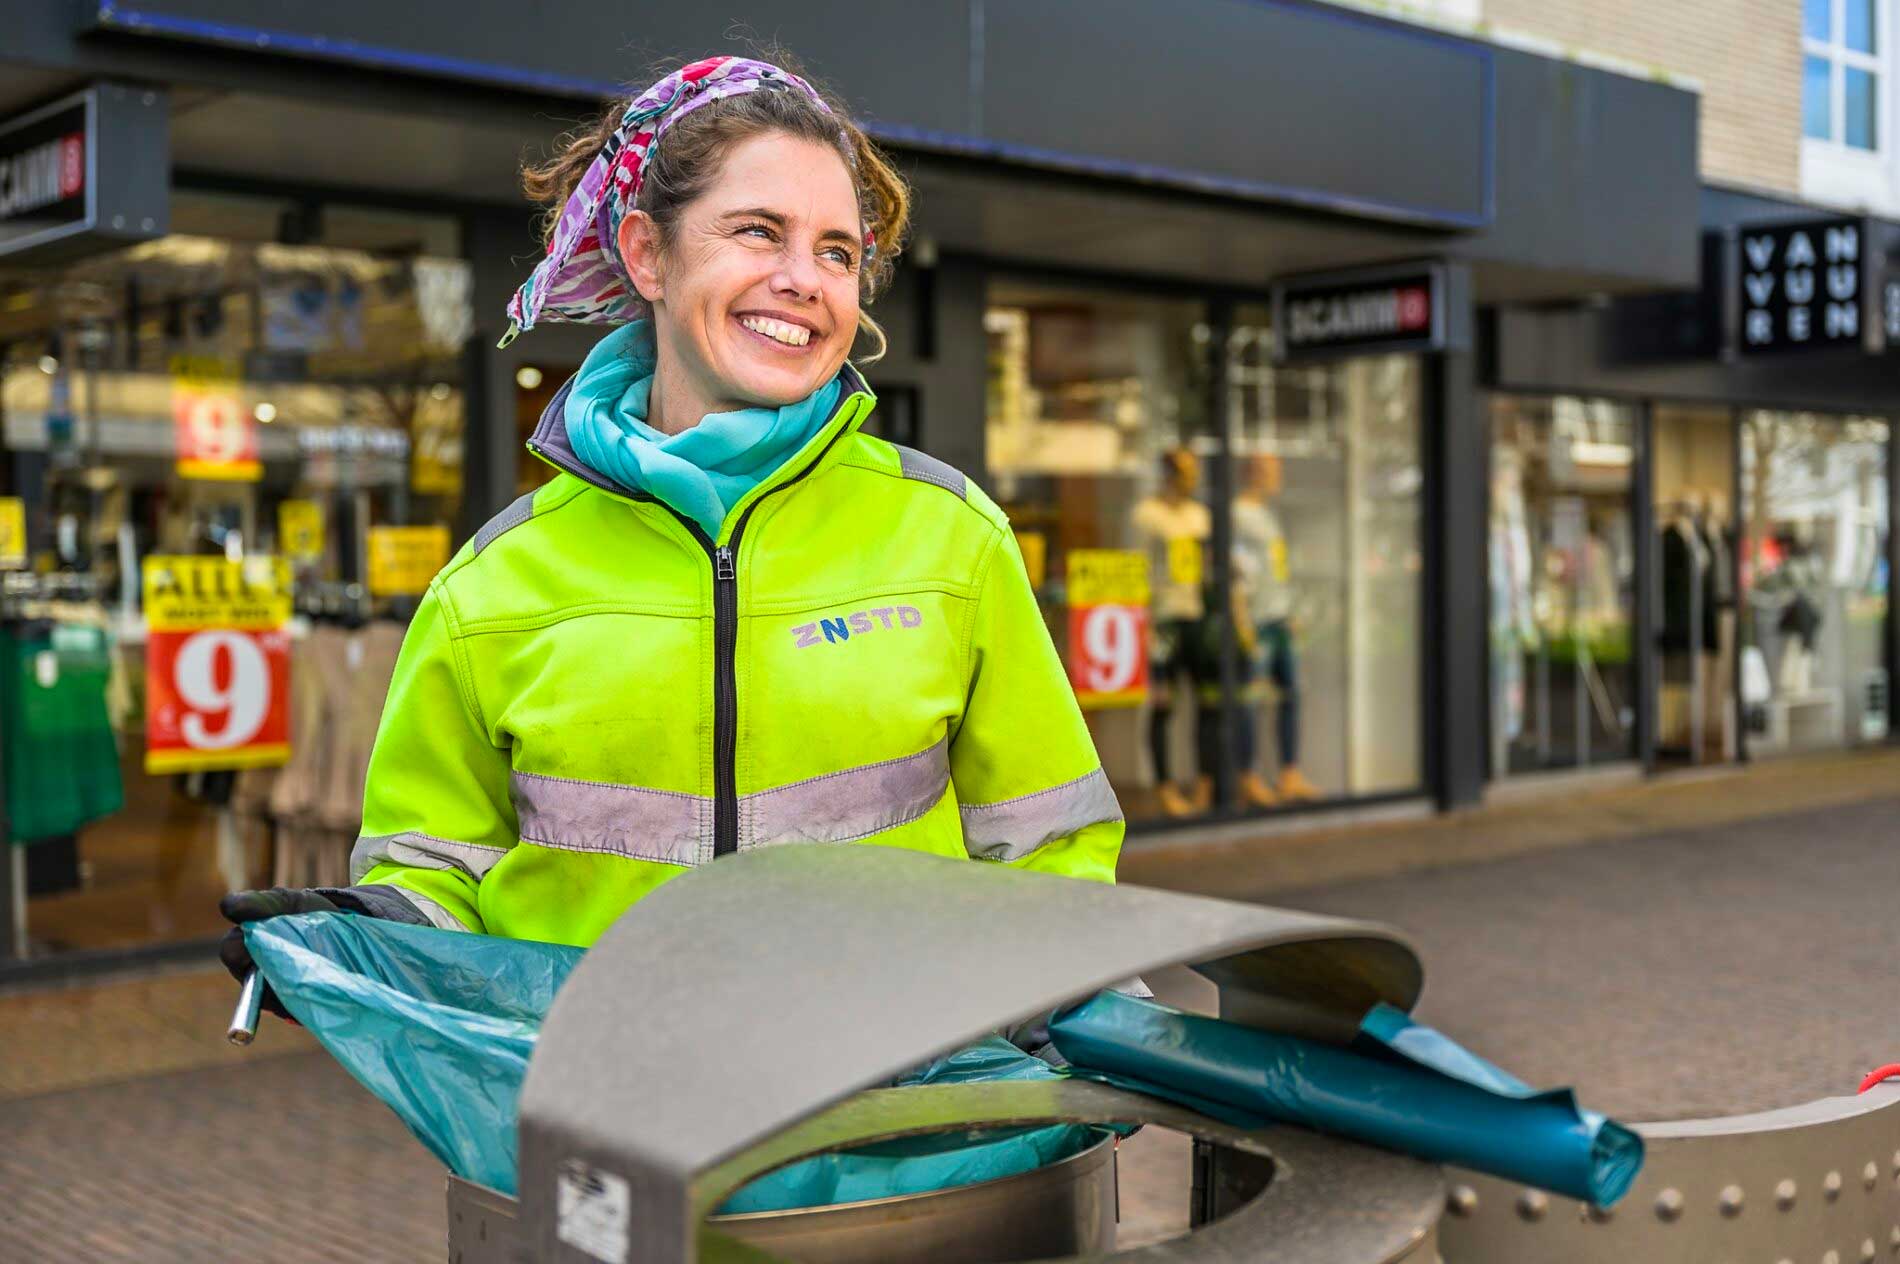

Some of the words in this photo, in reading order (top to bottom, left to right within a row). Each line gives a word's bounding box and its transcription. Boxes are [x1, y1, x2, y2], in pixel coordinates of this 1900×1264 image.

[1744, 225, 1858, 271] VAN
[1744, 264, 1857, 308] VUU
[1746, 301, 1858, 345] REN
[190, 396, 247, 461] 9
[791, 605, 923, 649] ZNSTD
[1084, 603, 1139, 692] 9
[174, 630, 271, 749] 9
